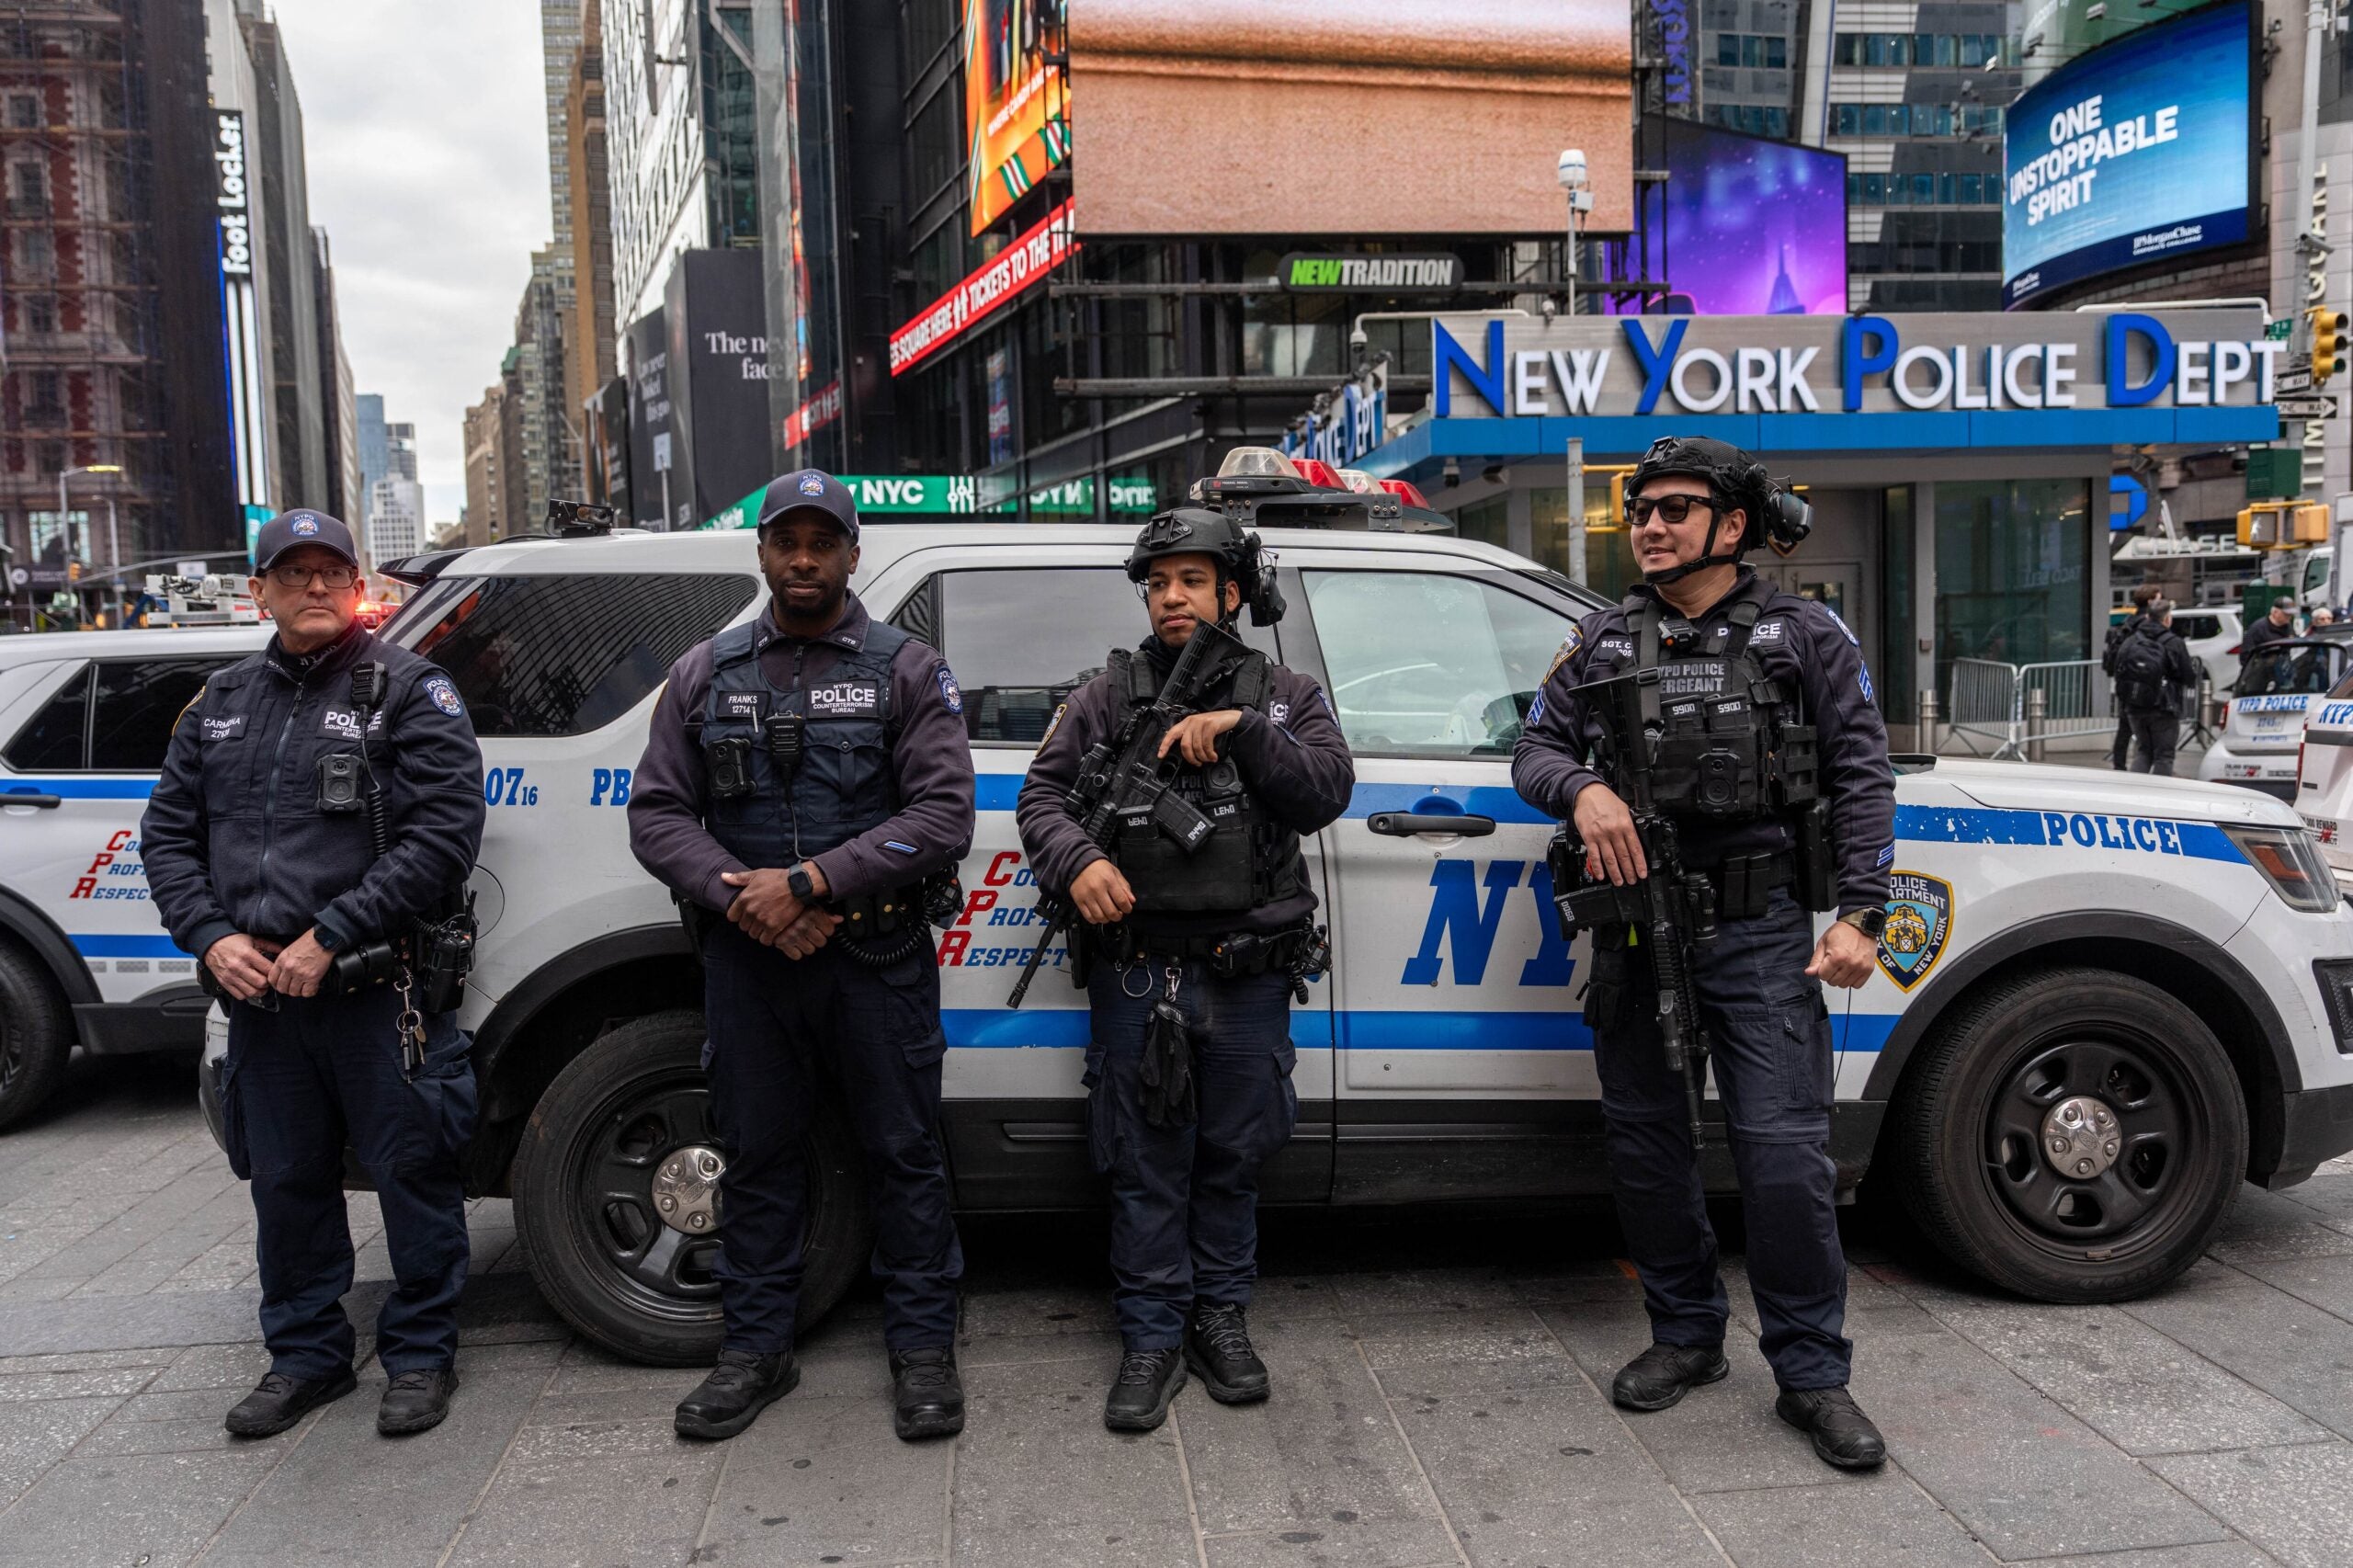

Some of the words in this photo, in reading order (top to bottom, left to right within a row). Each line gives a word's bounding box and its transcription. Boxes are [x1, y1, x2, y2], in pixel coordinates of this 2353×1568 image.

[2050, 94, 2103, 146] ONE
[215, 115, 245, 208] Locker
[2009, 105, 2178, 206] UNSTOPPABLE
[2028, 168, 2097, 226] SPIRIT
[899, 318, 931, 361] SQUARE
[930, 301, 953, 342] HERE
[969, 258, 1010, 313] TICKETS
[1010, 247, 1028, 284] TO
[1028, 228, 1051, 272] THE
[705, 331, 746, 355] The
[1432, 318, 1611, 417] NEW
[1620, 318, 1822, 415] YORK
[1843, 315, 2077, 411] POLICE
[2106, 312, 2288, 407] DEPT
[862, 479, 924, 505] NYC
[1601, 641, 1621, 649] SGT.
[1659, 664, 1679, 677] YPD
[1683, 664, 1724, 676] POLICE
[811, 688, 875, 704] POLICE
[1660, 677, 1724, 694] ERGEANT
[728, 695, 757, 704] FRANKS
[732, 705, 751, 714] 12714
[2237, 698, 2262, 711] NYPD
[2262, 696, 2309, 711] POLICE
[324, 710, 382, 729] POLE
[2042, 812, 2180, 855] POLICE
[69, 877, 152, 900] RESPEC
[1890, 876, 1928, 892] OLICE
[1889, 888, 1946, 910] ARTMENT
[1931, 916, 1948, 948] YORK
[937, 930, 1068, 967] RESPECT
[1881, 953, 1896, 969] OF
[1913, 950, 1934, 975] NEW
